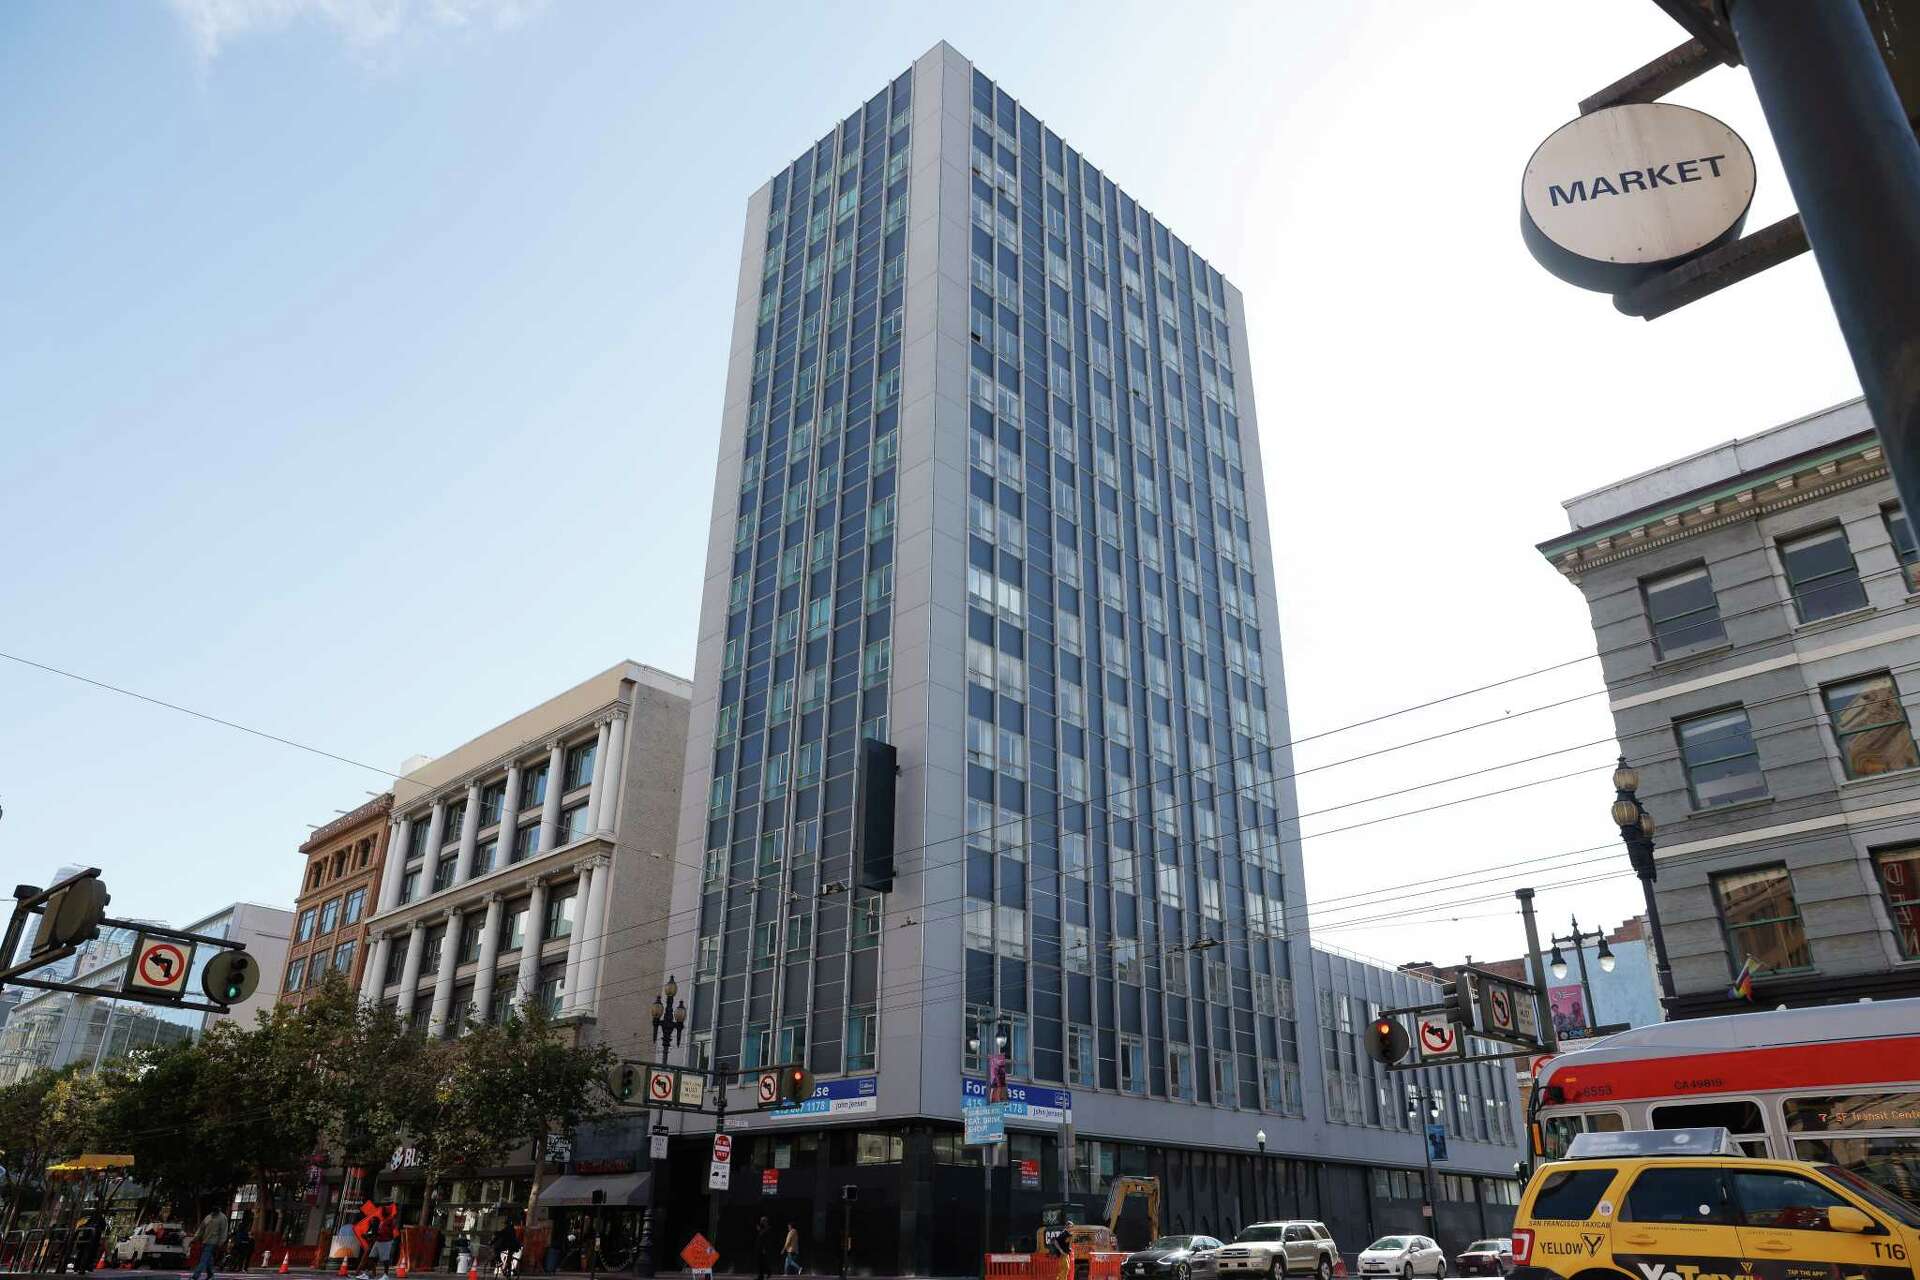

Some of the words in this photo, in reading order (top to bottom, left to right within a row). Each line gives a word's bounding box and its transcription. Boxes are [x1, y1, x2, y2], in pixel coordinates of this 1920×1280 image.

[1548, 155, 1725, 206] MARKET
[966, 1081, 986, 1095] For
[1541, 1242, 1583, 1255] YELLOW
[1871, 1242, 1905, 1260] T16
